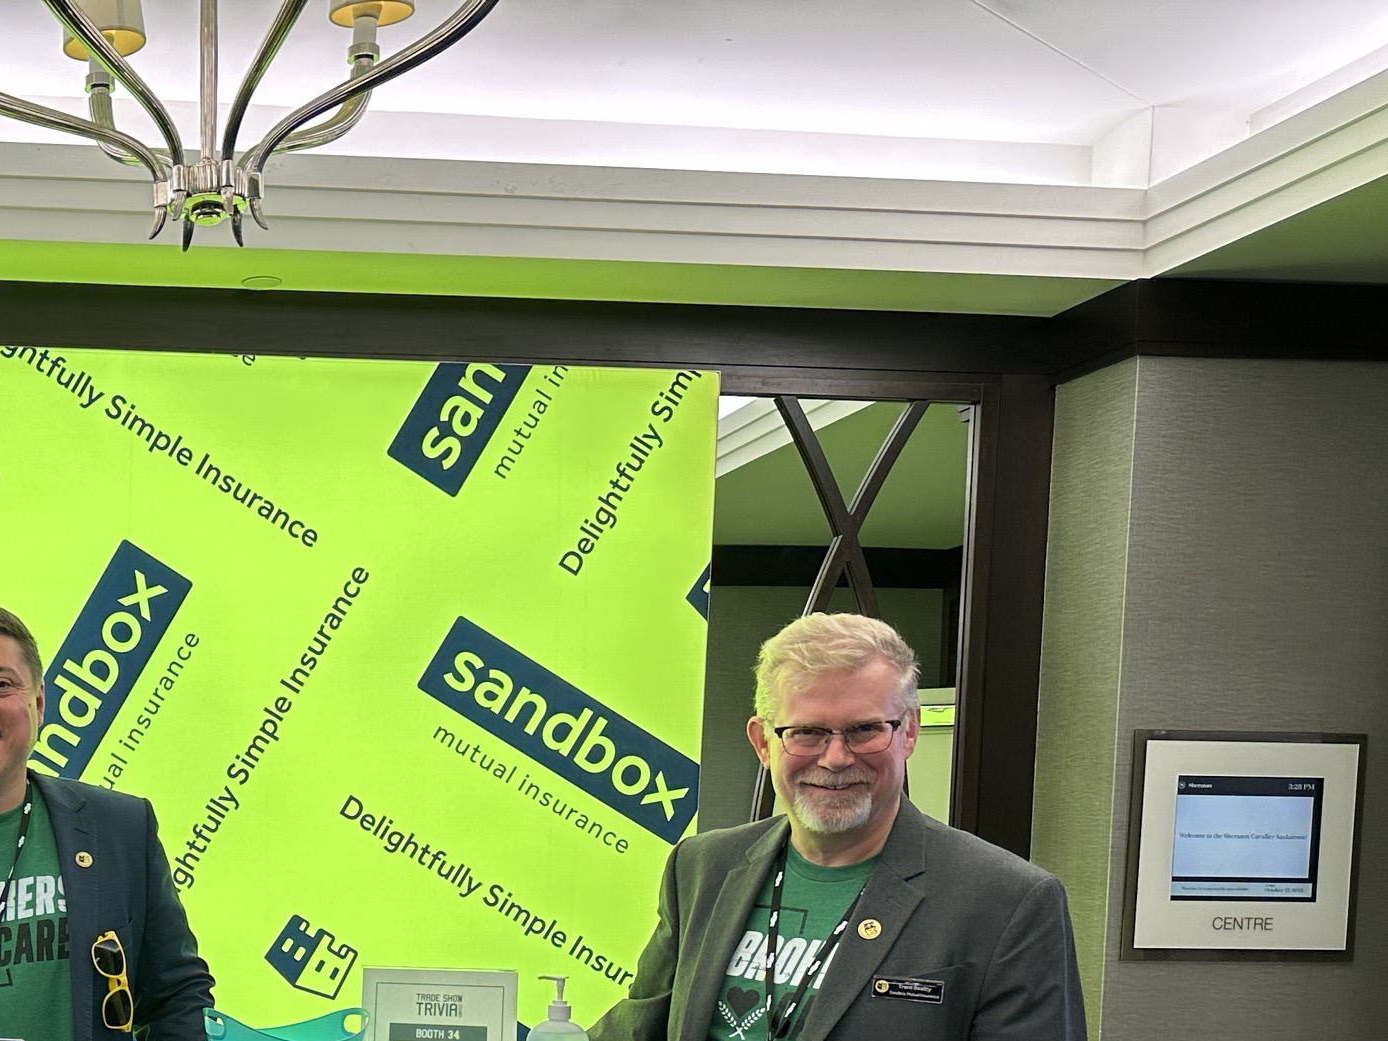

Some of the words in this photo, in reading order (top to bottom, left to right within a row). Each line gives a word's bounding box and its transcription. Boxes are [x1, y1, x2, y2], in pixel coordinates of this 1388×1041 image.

[105, 394, 192, 468] Simple
[196, 453, 319, 548] Insurance
[494, 388, 552, 479] mutual
[559, 422, 664, 576] Delightfully
[119, 633, 200, 752] insurance
[172, 785, 240, 893] ghtfully
[227, 691, 292, 786] Simple
[279, 566, 370, 694] Insurance
[443, 649, 690, 822] sandbox
[433, 723, 515, 785] mutual
[519, 773, 630, 855] insurance
[339, 795, 482, 898] Delightfully
[483, 884, 567, 950] Simple
[569, 935, 634, 990] Insur
[1212, 917, 1273, 931] CENTRE
[416, 993, 441, 1002] TRADE
[443, 994, 463, 1003] SHOW
[416, 1002, 458, 1017] TRIVIA
[416, 1028, 444, 1039] BOOTH
[448, 1030, 460, 1040] 34
